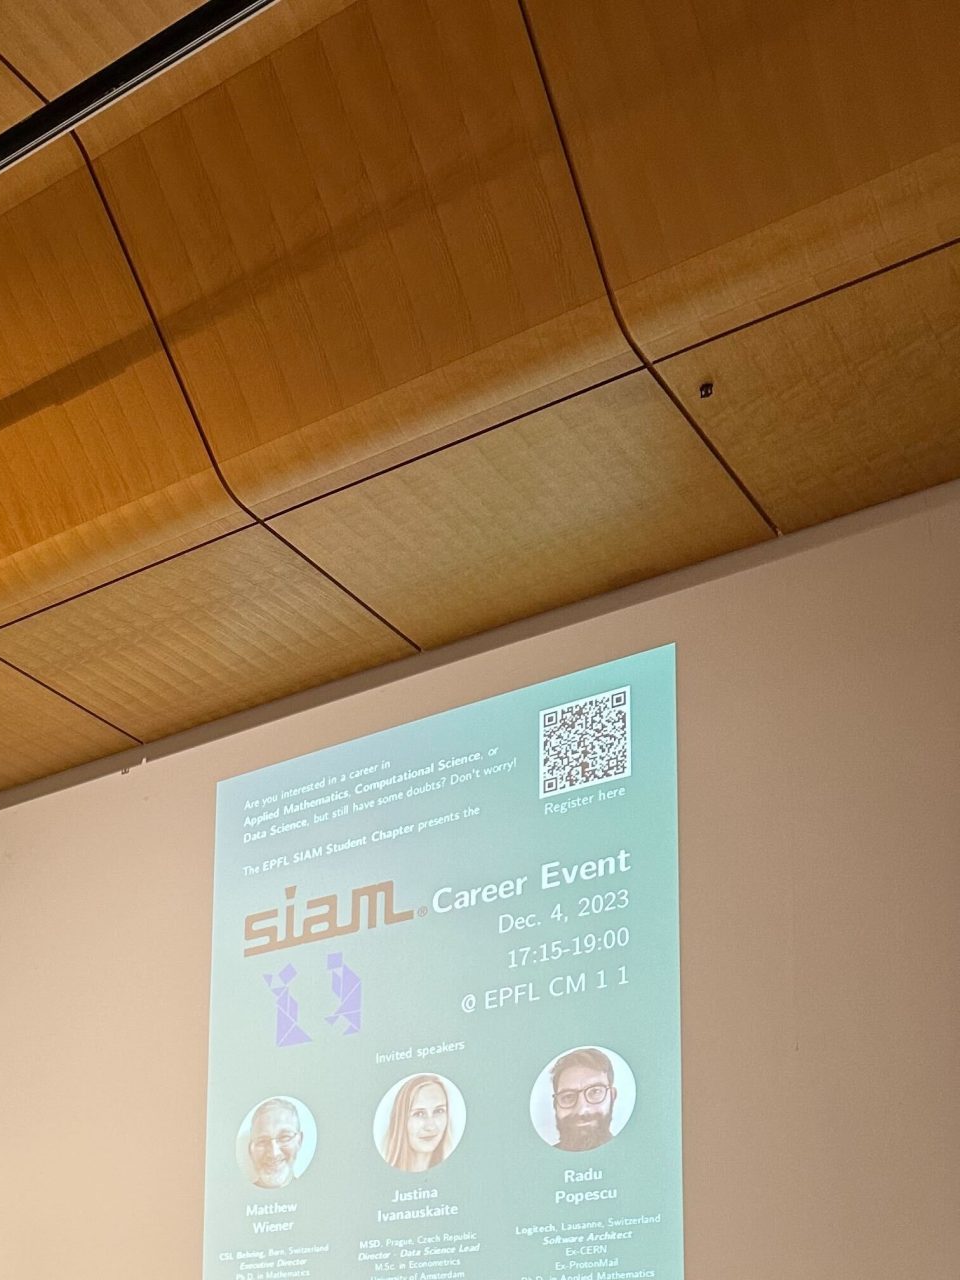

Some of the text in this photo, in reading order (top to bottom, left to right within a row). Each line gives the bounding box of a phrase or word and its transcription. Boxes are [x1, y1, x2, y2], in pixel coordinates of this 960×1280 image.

[244, 799, 260, 810] Are
[261, 794, 278, 807] you
[281, 779, 325, 799] interested
[328, 776, 337, 785] in
[349, 764, 379, 779] career
[381, 760, 390, 769] in
[244, 747, 499, 827] Applied Mathematics, Computational Science, or
[243, 758, 517, 844] Data Science, but still have some doubts? Don't worry!
[544, 786, 627, 815] Register here
[242, 806, 480, 876] The EPFL SIAM Student Chapter presents the
[432, 849, 632, 914] Career Event
[498, 889, 630, 934] Dec. 4, 2023
[508, 927, 630, 969] 17:15-19:00
[461, 965, 630, 1013] @ EPFL CM 1 1
[376, 1040, 465, 1064] Invited speakers
[564, 1168, 603, 1183] Radu
[391, 1187, 439, 1202] Justina
[555, 1189, 618, 1205] Popescu
[246, 1202, 298, 1216] Matthew
[377, 1204, 459, 1222] Ivanauskaite
[252, 1221, 295, 1234] Wiener
[607, 1214, 661, 1227] Switzerland
[443, 1231, 477, 1242] Republic
[542, 1230, 633, 1246] Software Architect
[400, 1249, 421, 1258] Data
[424, 1246, 455, 1256] Science
[458, 1243, 480, 1253] Lead
[565, 1245, 608, 1256] Ex-CERN
[409, 1273, 418, 1280] of
[597, 1269, 656, 1280] Mathematics
